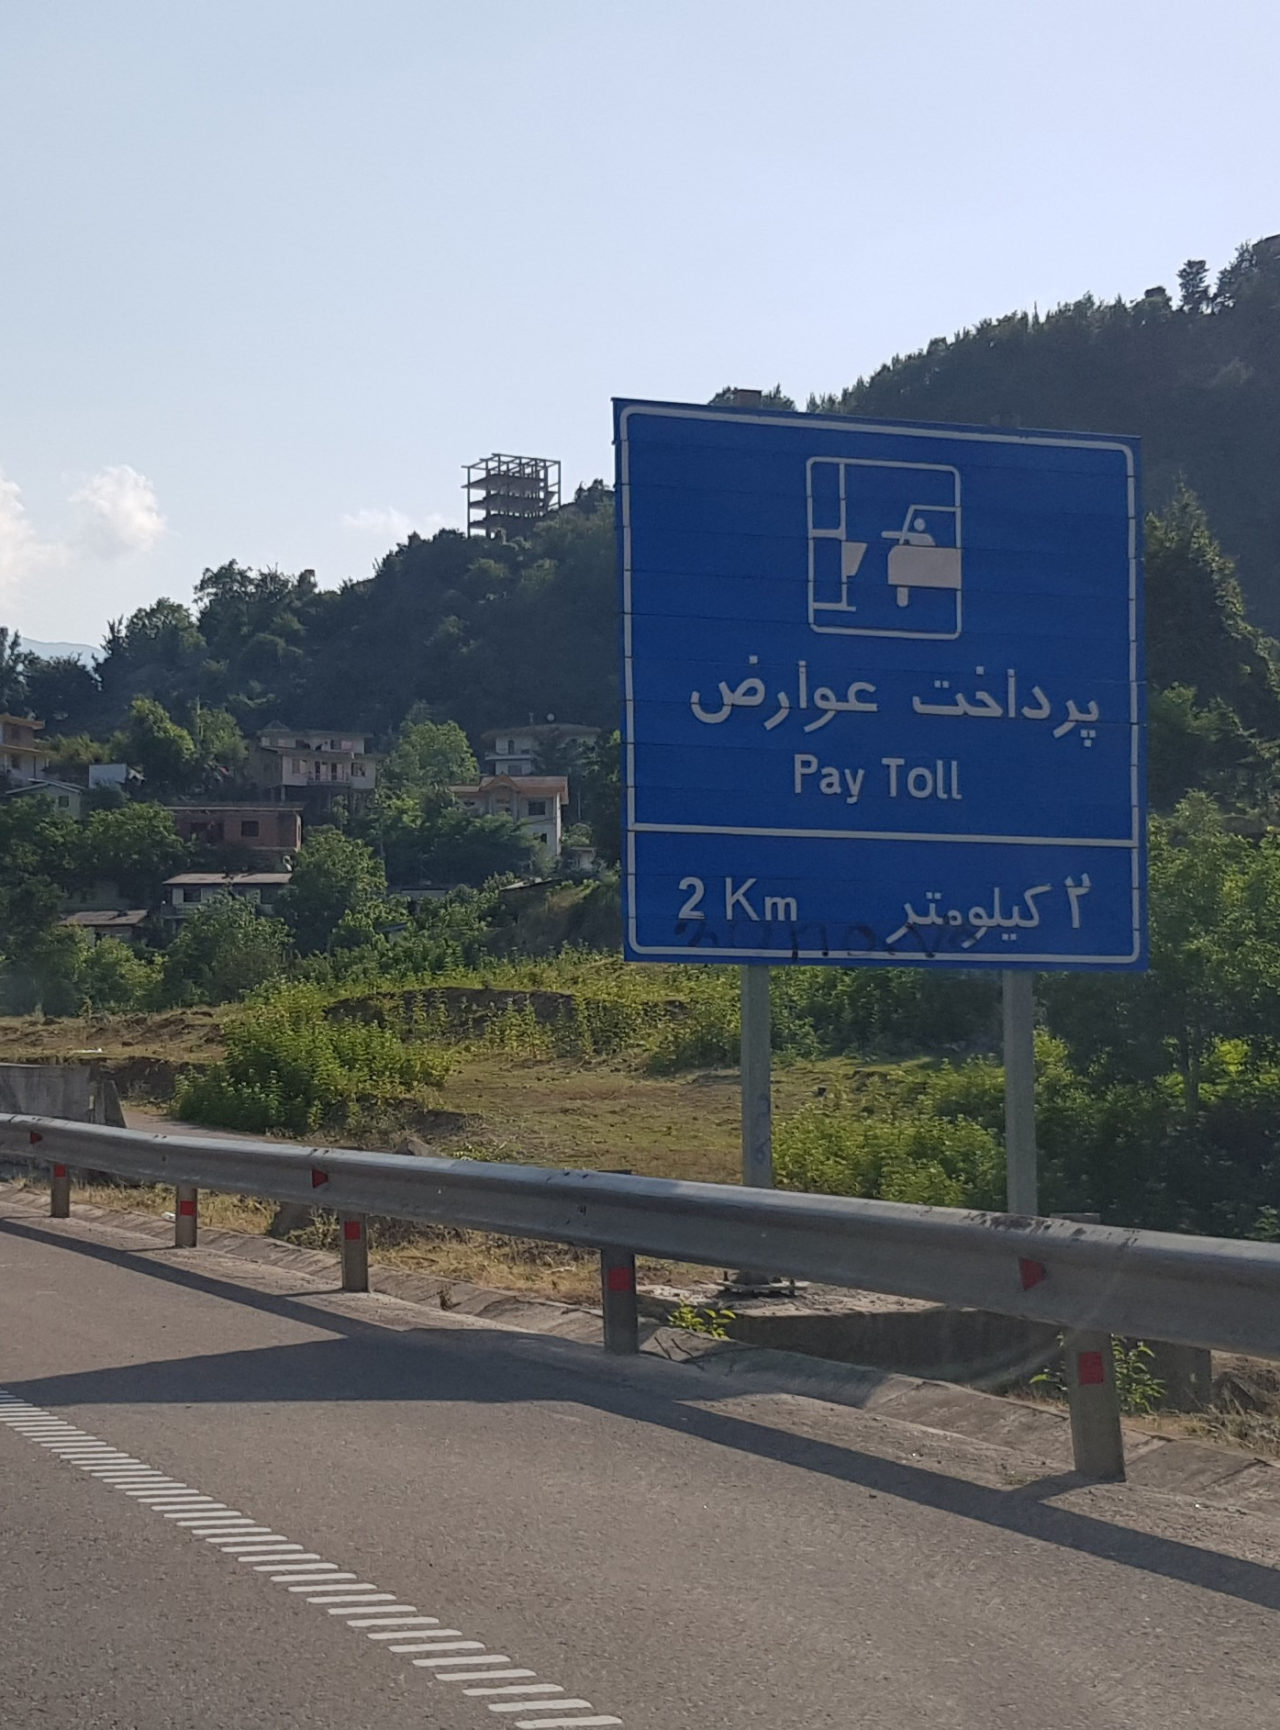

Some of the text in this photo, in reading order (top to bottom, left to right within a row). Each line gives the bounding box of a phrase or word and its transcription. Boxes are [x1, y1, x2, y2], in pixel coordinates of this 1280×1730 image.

[690, 655, 1101, 748] پرداخت عوارض
[793, 754, 963, 804] Pay Toll
[678, 876, 799, 922] 2 Km
[886, 883, 1053, 949] کیلومتر
[1063, 872, 1091, 929] ۲
